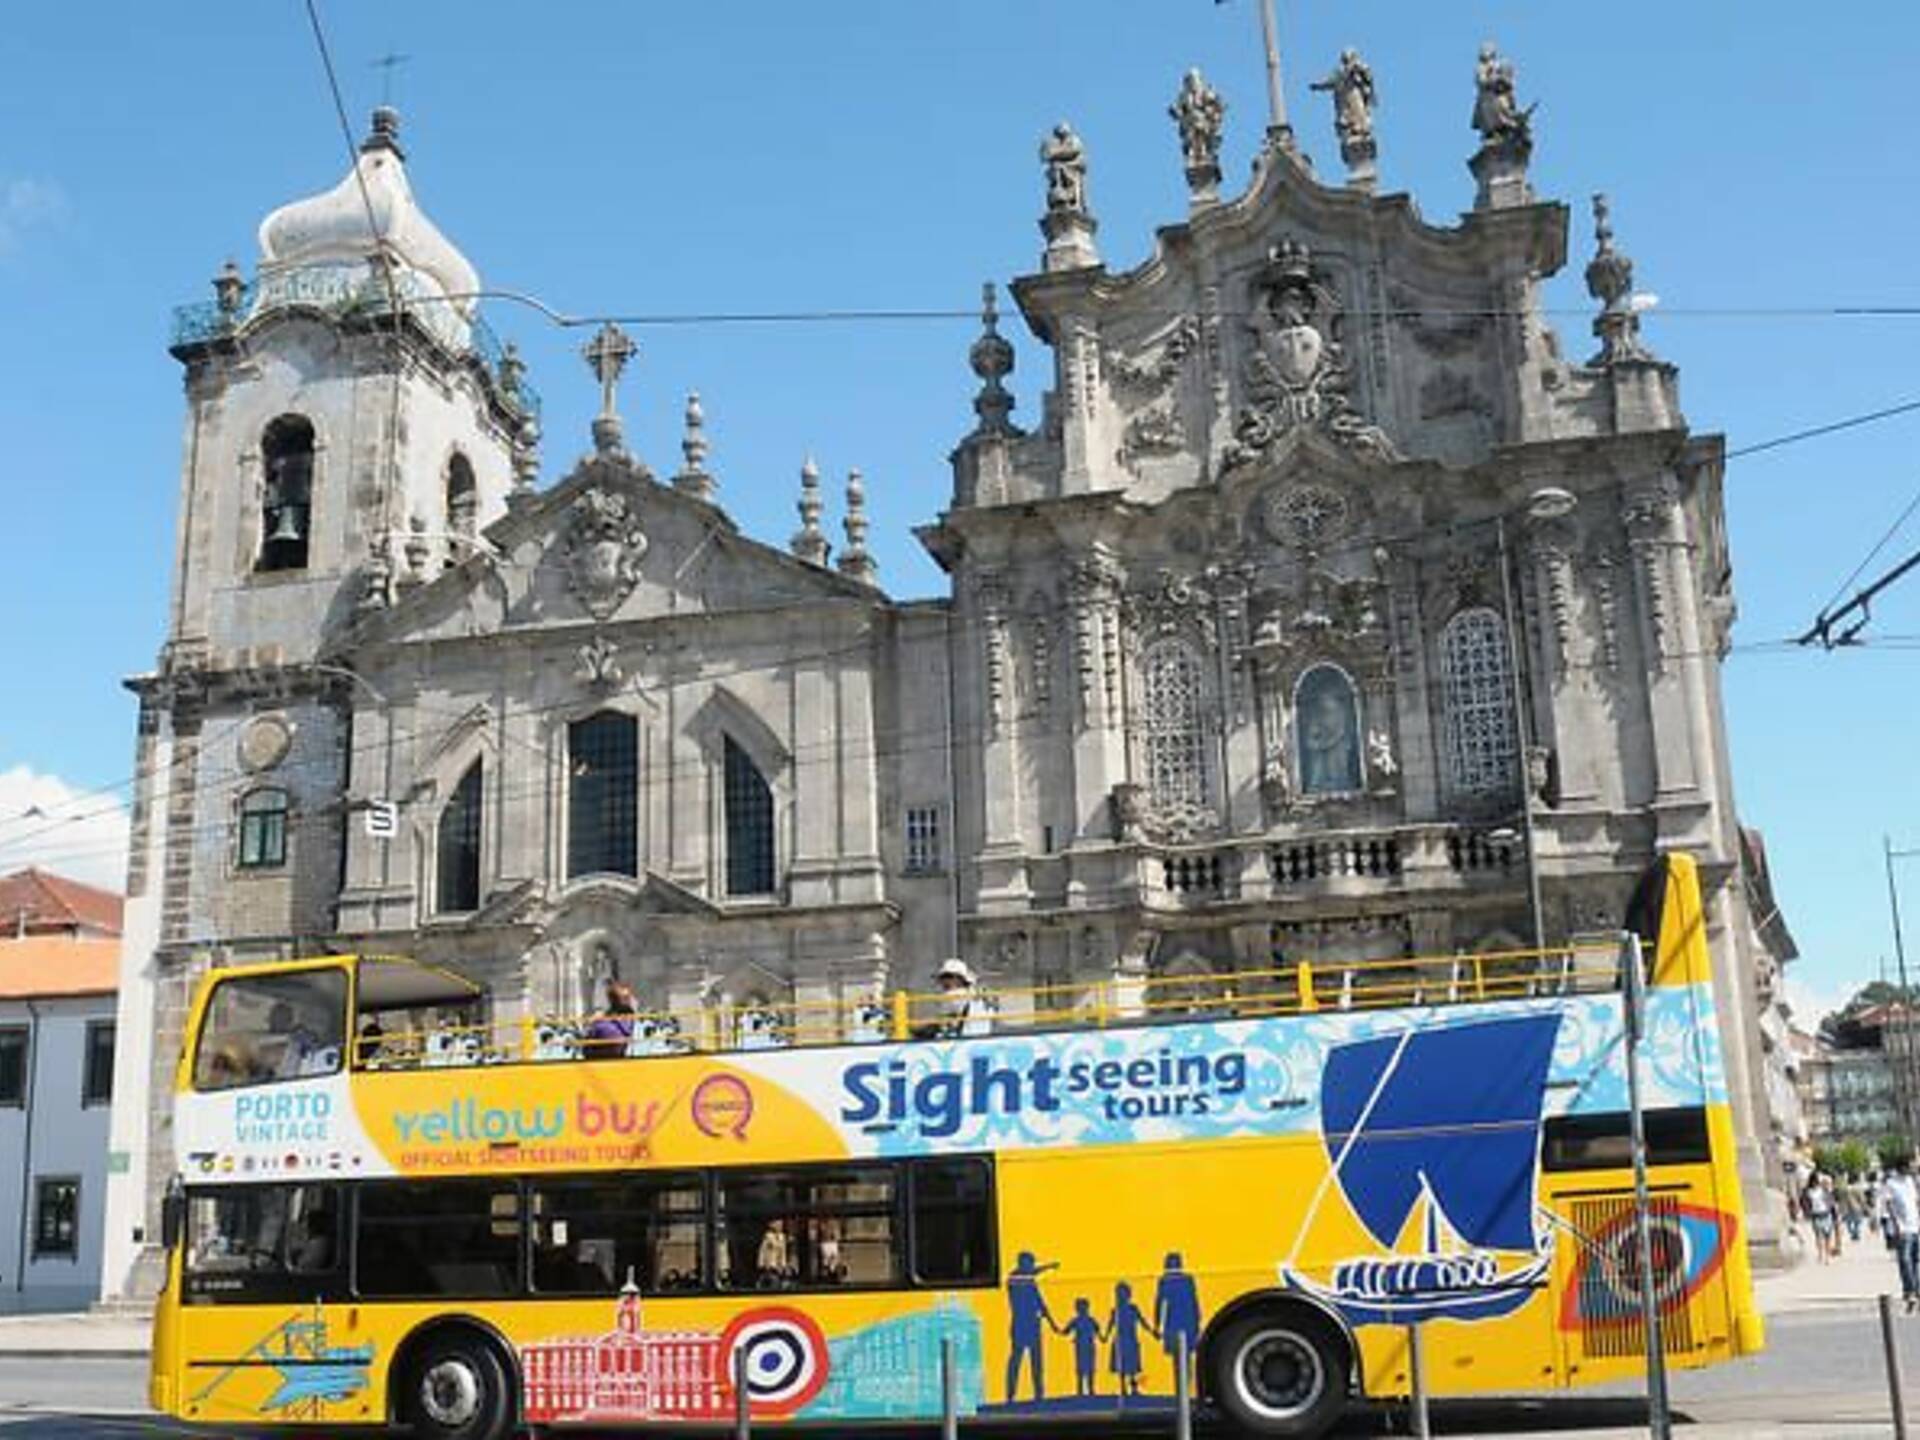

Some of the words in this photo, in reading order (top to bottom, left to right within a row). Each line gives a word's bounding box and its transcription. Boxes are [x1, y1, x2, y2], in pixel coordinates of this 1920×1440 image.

[236, 1092, 331, 1120] PORTO
[842, 1055, 1060, 1137] Sight
[1067, 1048, 1246, 1095] seeing
[1103, 1090, 1210, 1121] tours
[577, 1090, 660, 1137] bus
[236, 1122, 328, 1142] VINTAGE
[401, 1149, 471, 1167] OFFICIAL
[479, 1145, 589, 1166] SIGHTSEEING
[596, 1142, 650, 1162] TOURS
